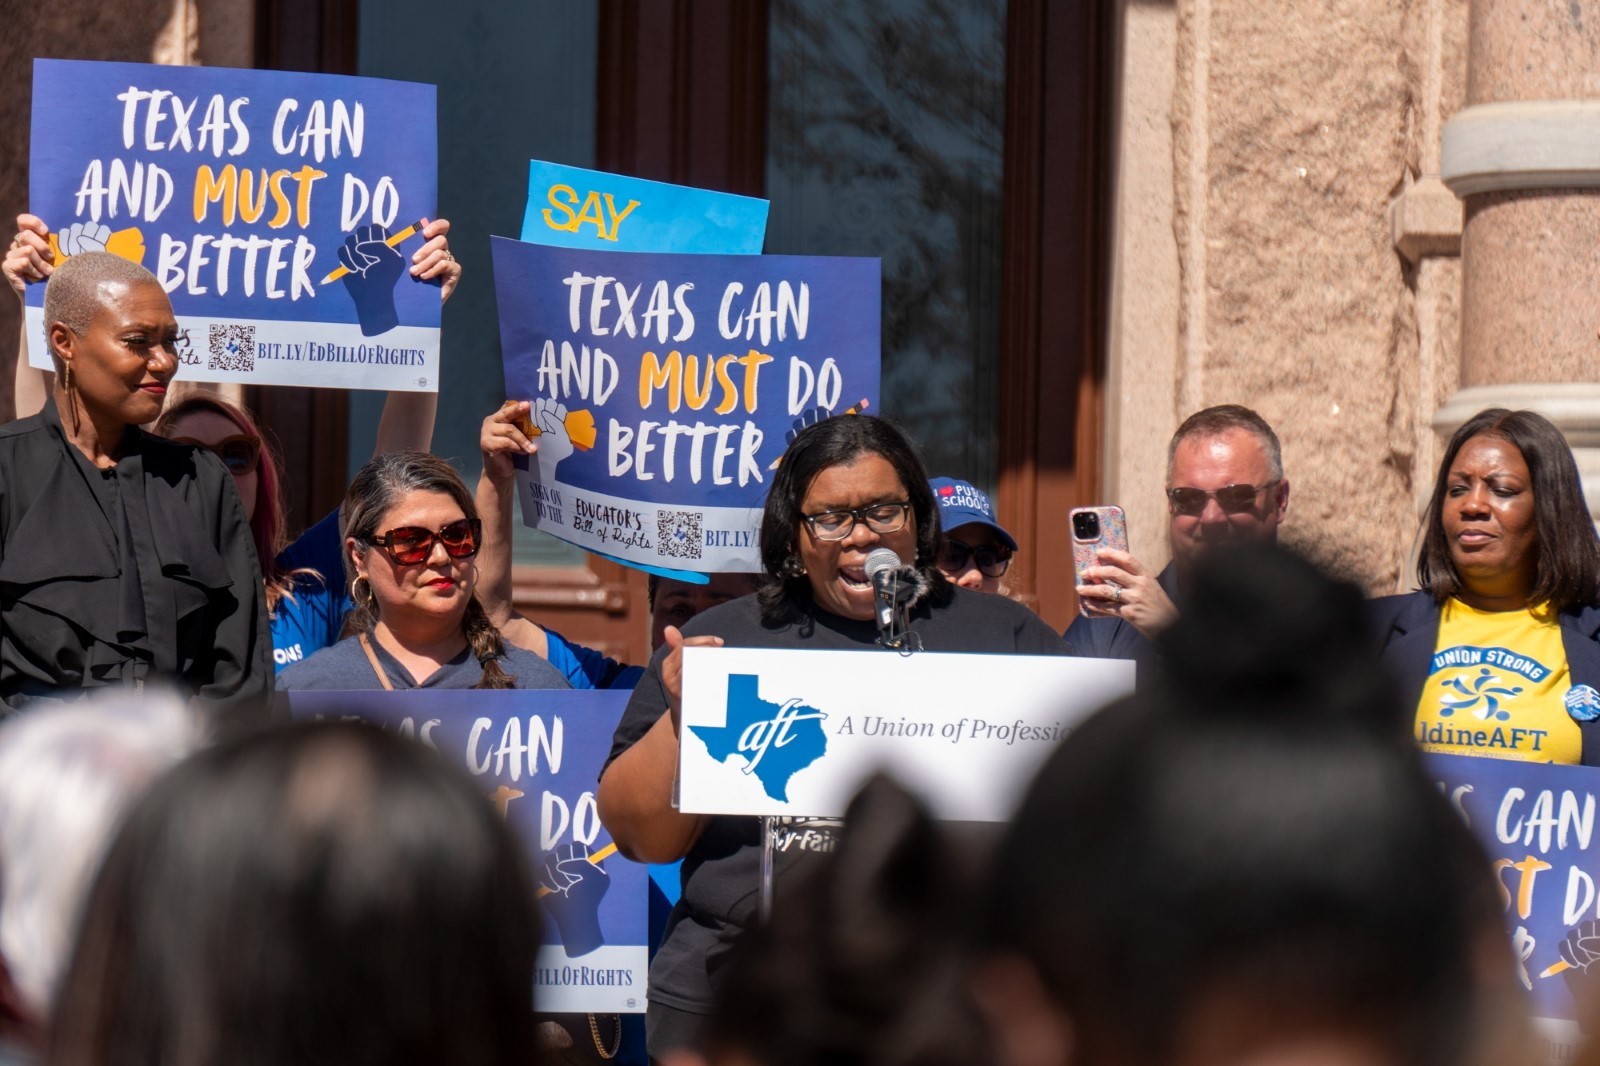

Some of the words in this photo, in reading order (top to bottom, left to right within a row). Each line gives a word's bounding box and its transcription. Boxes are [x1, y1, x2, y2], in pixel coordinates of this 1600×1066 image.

[117, 86, 250, 157] TEXAS
[272, 98, 365, 163] CAN
[75, 159, 174, 223] AND
[193, 164, 328, 229] MUST
[340, 172, 400, 232] DO
[541, 184, 641, 241] SAY
[156, 233, 316, 301] BETTER
[562, 271, 695, 344] TEXAS
[718, 280, 810, 347] CAN
[537, 340, 619, 406] AND
[638, 349, 774, 415] MUST
[788, 356, 843, 416] DO
[608, 417, 764, 488] BETTER
[529, 482, 549, 501] SIGN
[549, 488, 563, 507] ON
[533, 500, 548, 519] TO
[548, 505, 565, 526] THE
[575, 497, 642, 531] EDUCATOR'S
[573, 515, 593, 534] Bill
[597, 526, 609, 543] of
[609, 528, 654, 550] Rights
[705, 529, 762, 548] BIT.LY/
[273, 643, 303, 665] ONS
[1433, 649, 1482, 668] UNION
[1486, 650, 1544, 680] STRONG
[465, 714, 564, 781] CAN
[738, 698, 828, 775] aft
[836, 716, 855, 736] A
[863, 716, 934, 738] Union
[941, 717, 967, 745] of
[969, 719, 1074, 746] Professio
[1420, 721, 1548, 751] ldineAFT
[540, 790, 600, 851] DO
[1495, 787, 1596, 854] CAN
[1562, 865, 1600, 926] D
